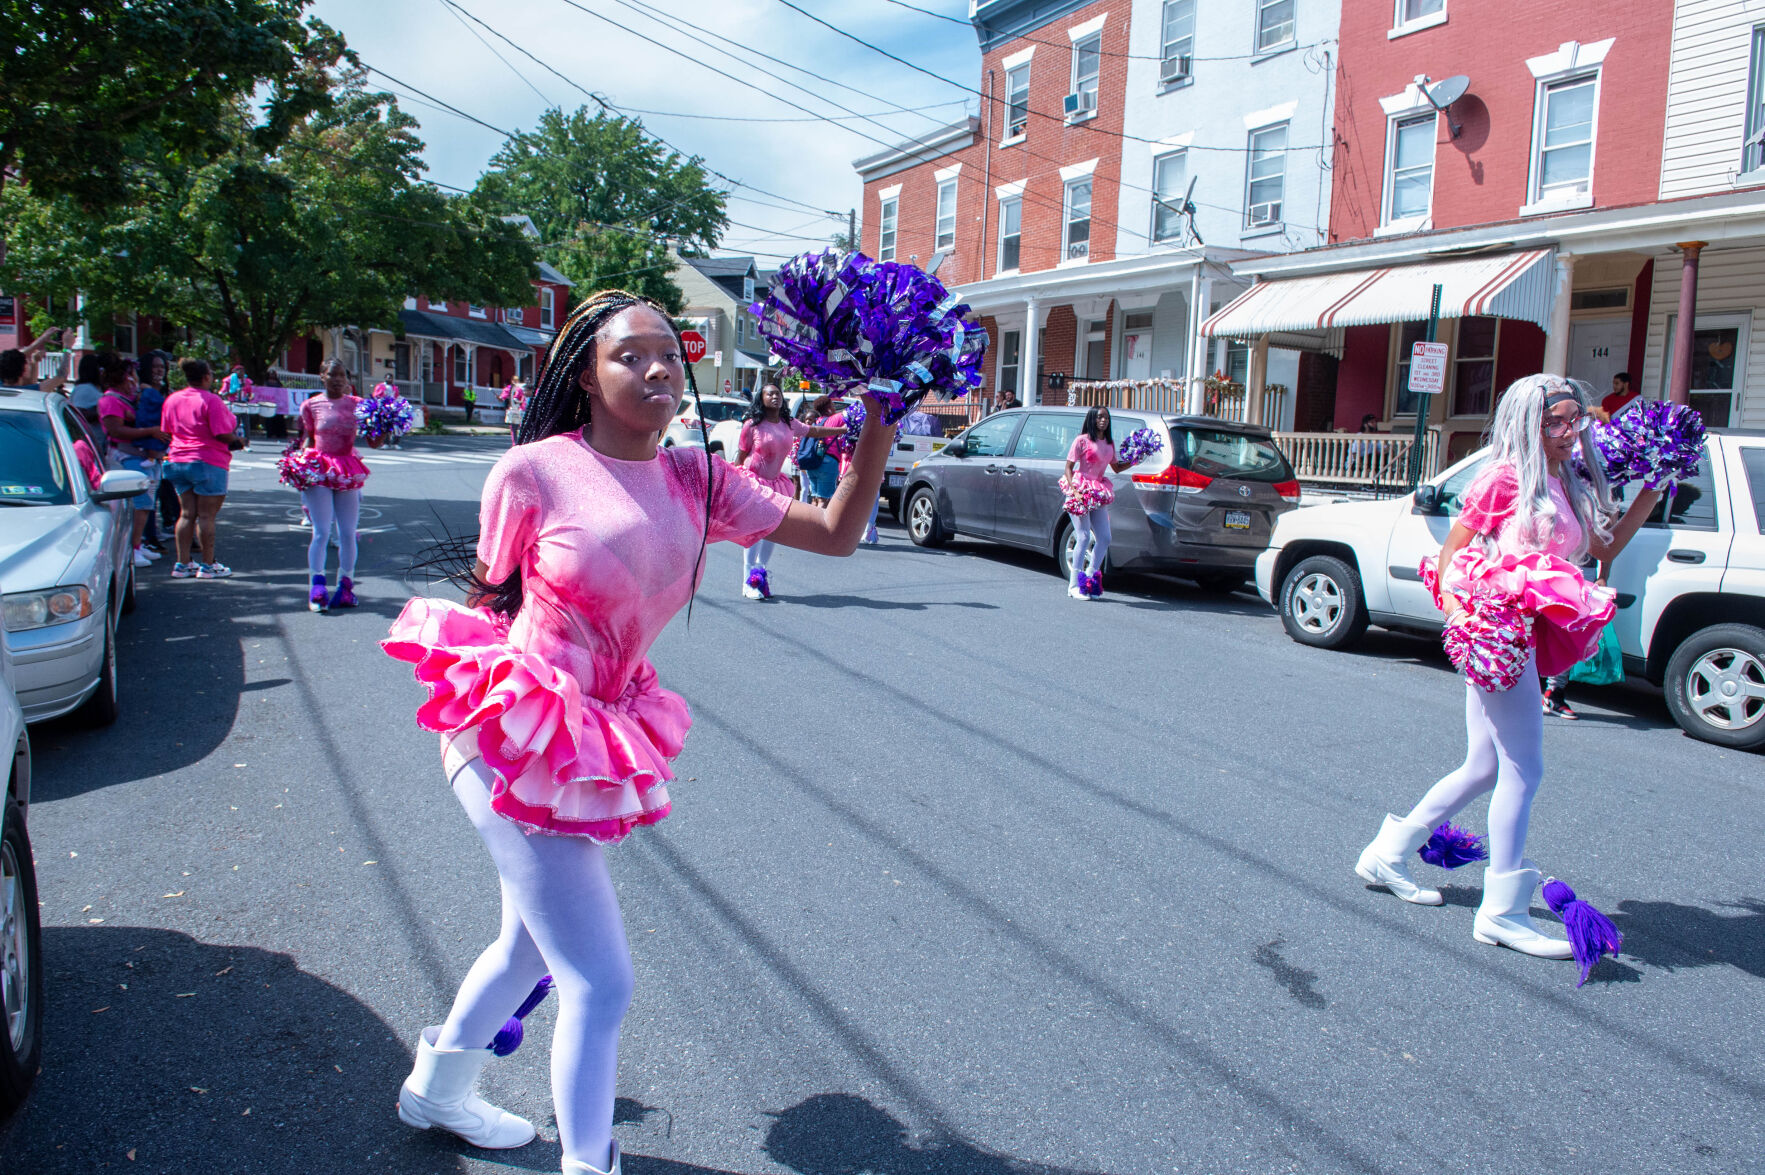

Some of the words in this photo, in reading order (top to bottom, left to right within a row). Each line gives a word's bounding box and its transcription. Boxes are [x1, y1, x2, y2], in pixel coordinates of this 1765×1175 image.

[683, 340, 705, 354] TOP
[1415, 344, 1424, 355] NO
[1592, 347, 1608, 358] 144
